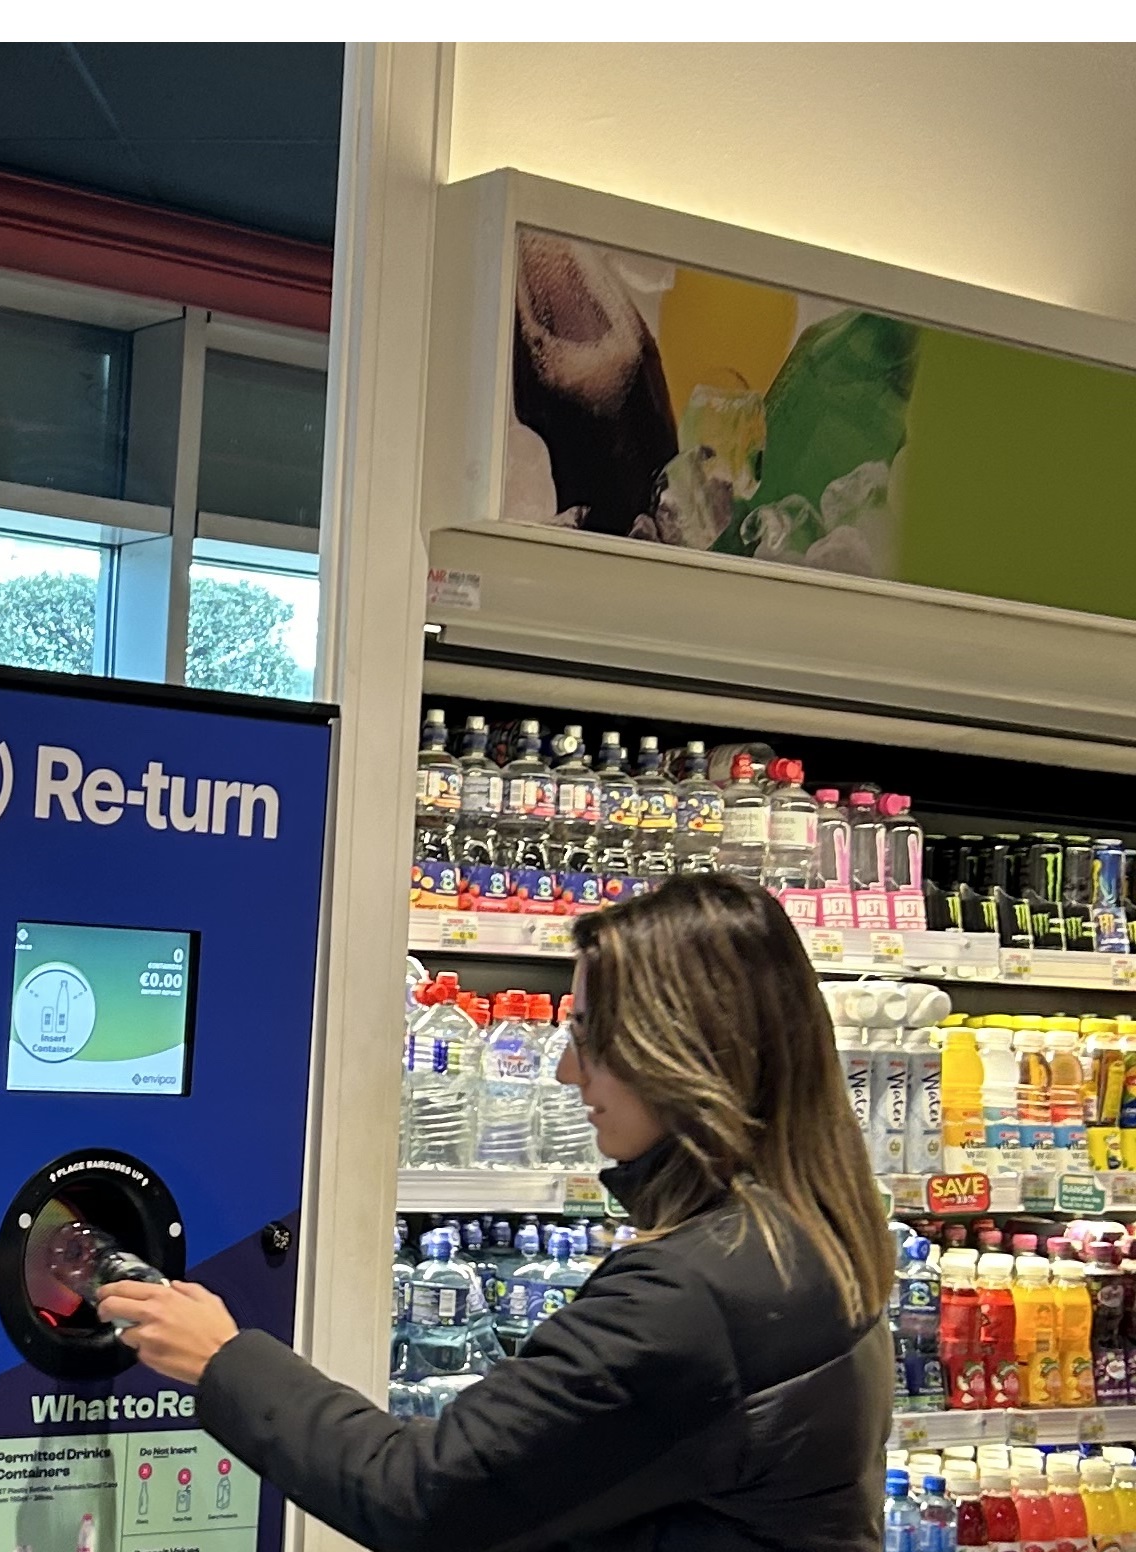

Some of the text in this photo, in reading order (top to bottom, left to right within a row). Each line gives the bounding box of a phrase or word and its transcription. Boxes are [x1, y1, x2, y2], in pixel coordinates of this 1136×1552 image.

[34, 744, 279, 839] Re-turn
[173, 948, 184, 963] 0
[140, 972, 183, 988] €0.00
[41, 1034, 66, 1043] Insert
[32, 1044, 74, 1053] Container
[143, 1074, 176, 1086] envipco
[887, 1071, 906, 1121] Water
[922, 1071, 941, 1122] Water
[56, 1160, 144, 1180] PLACE BARCODES UP
[931, 1177, 985, 1197] SAVE
[31, 1390, 197, 1424] What to Re
[67, 1447, 111, 1460] Drinks
[140, 1446, 197, 1456] Do Not Insert
